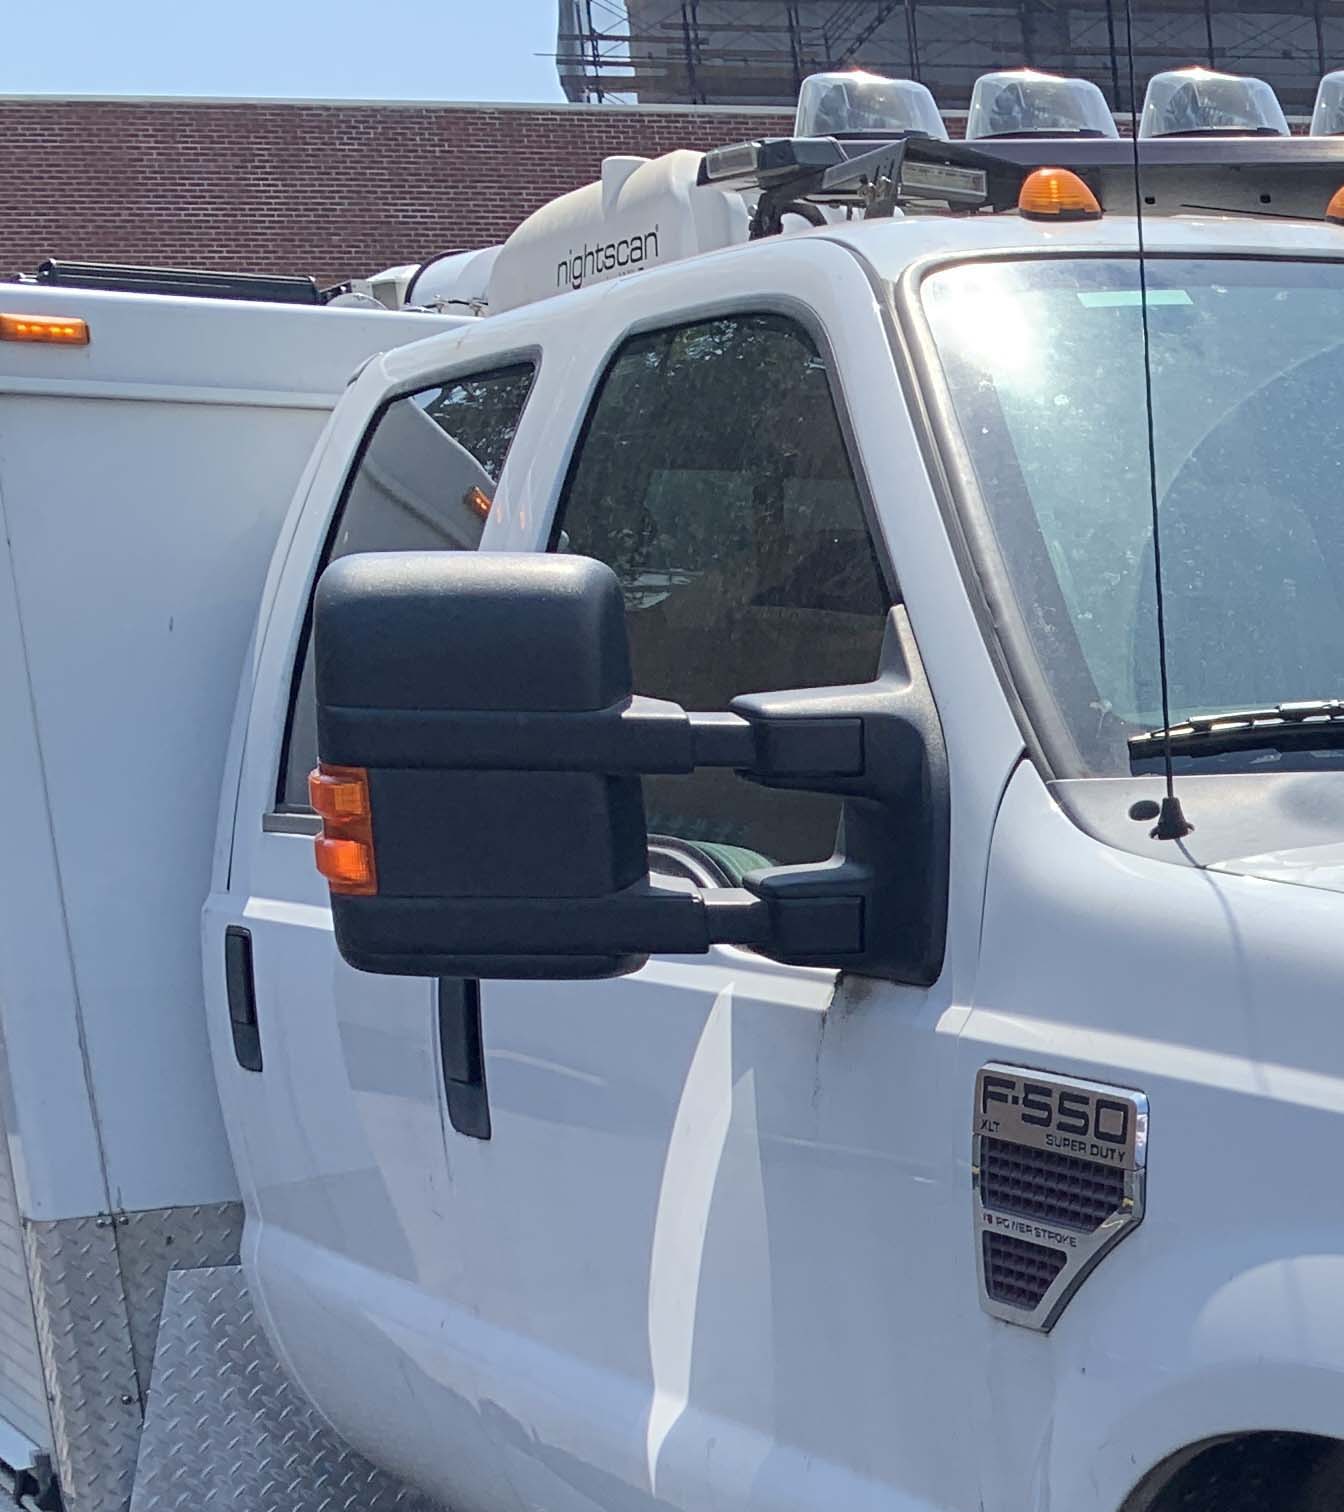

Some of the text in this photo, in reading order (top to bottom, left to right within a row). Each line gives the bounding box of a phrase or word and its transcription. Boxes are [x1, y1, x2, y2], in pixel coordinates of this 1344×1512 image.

[557, 231, 659, 290] nightscan
[979, 1119, 1001, 1134] XLT
[983, 1075, 1129, 1145] F-550
[1046, 1134, 1126, 1163] SUPER DUTY
